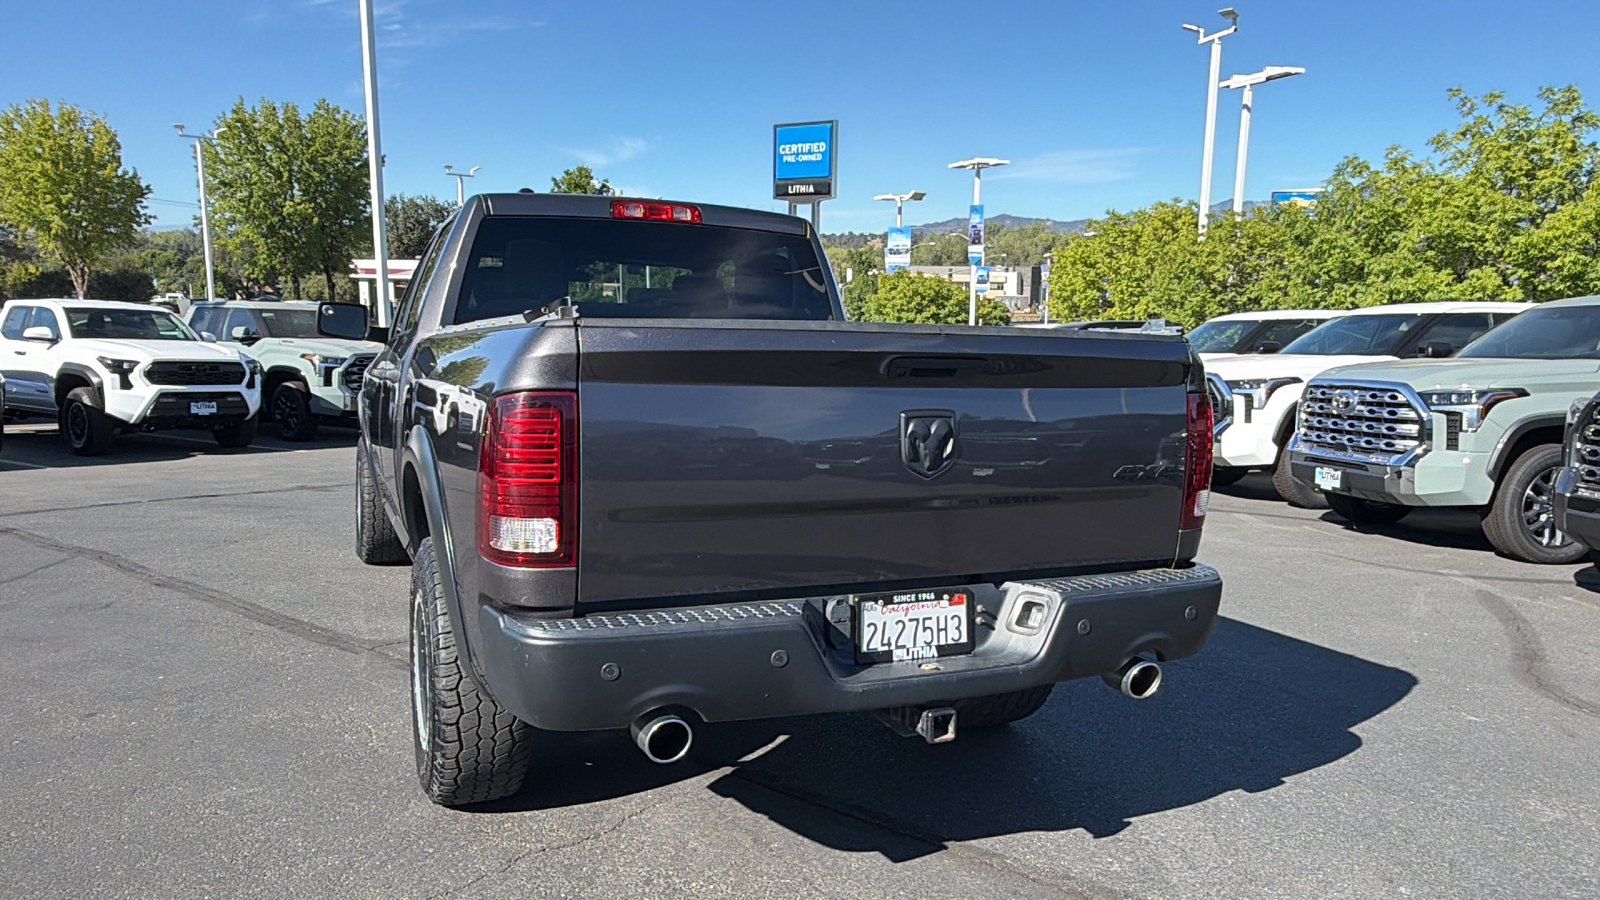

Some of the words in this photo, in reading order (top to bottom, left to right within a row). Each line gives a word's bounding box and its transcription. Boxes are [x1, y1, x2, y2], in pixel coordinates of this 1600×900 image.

[779, 142, 826, 154] CERTIFIED
[783, 153, 822, 163] PRE-OWNED
[788, 184, 814, 194] LITHIA
[893, 594, 916, 603] SINCE
[918, 592, 936, 601] 1946
[866, 614, 962, 652] 24275H3
[903, 645, 938, 659] LITHIA
